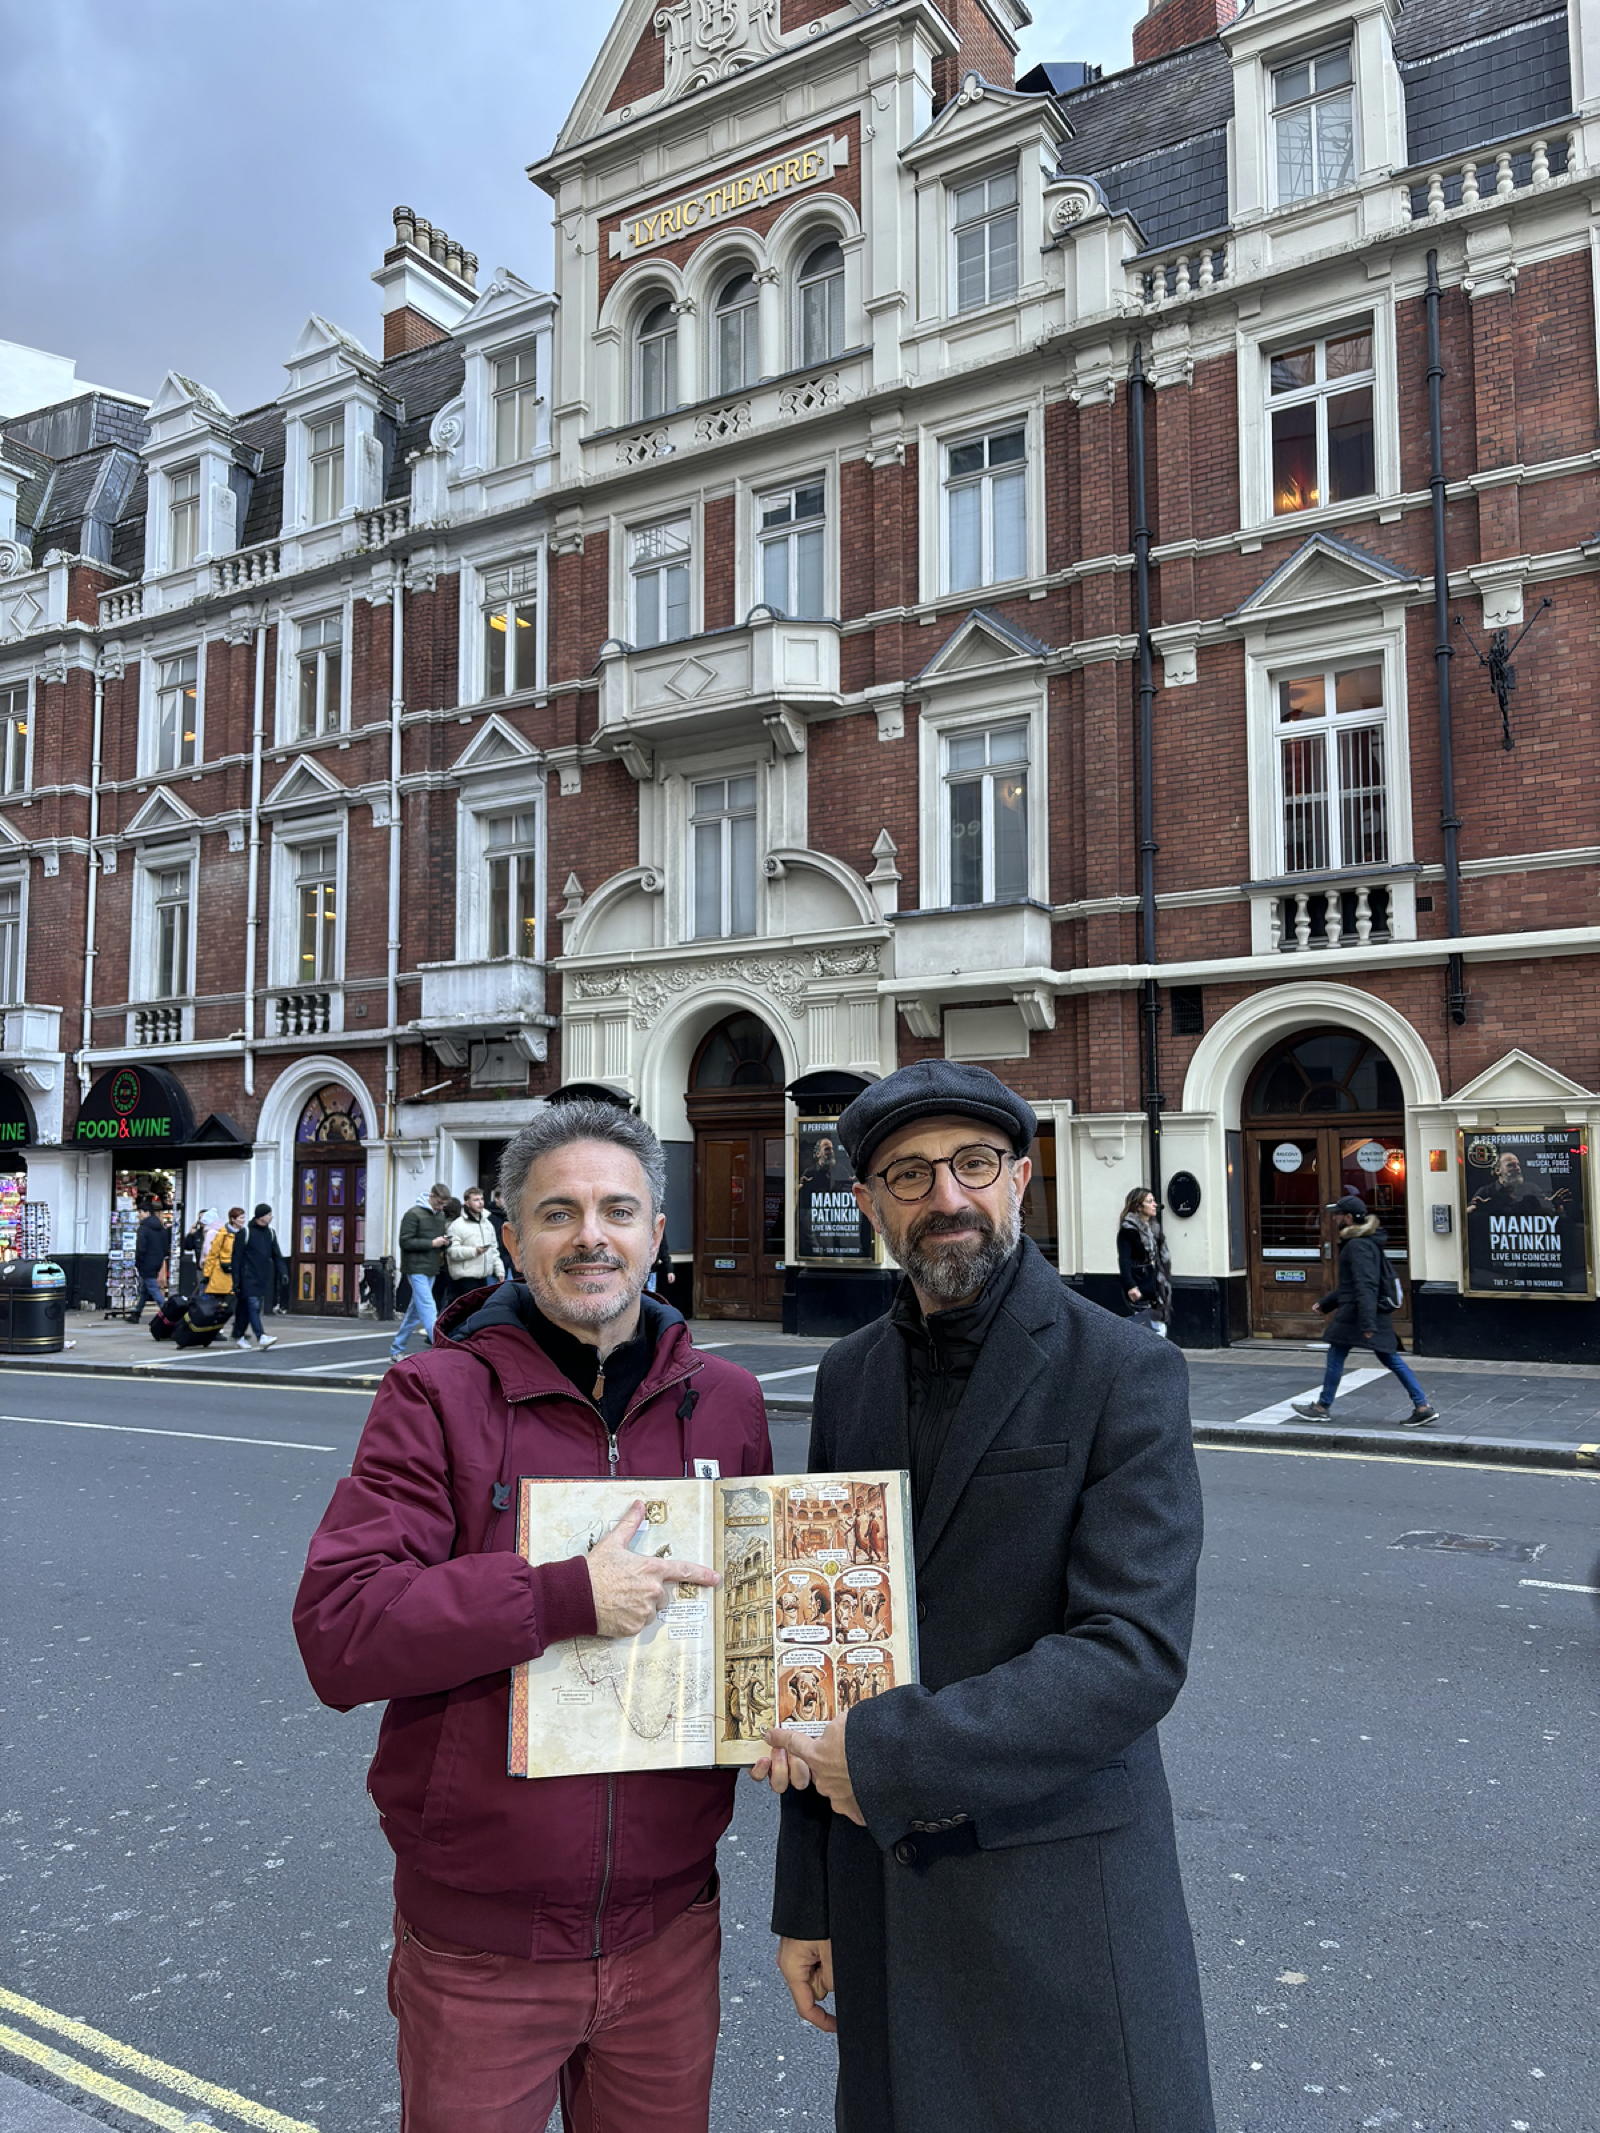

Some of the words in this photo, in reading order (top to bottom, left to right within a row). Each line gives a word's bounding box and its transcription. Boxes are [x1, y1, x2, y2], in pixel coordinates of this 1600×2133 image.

[635, 200, 699, 249] LYRIC
[705, 151, 818, 218] THEATRE
[1481, 1134, 1546, 1145] PERFORMANCES
[1548, 1134, 1569, 1143] ONLY
[811, 1192, 857, 1207] MANDY
[811, 1208, 860, 1222] PATINKIN
[1489, 1216, 1560, 1233] MANDY
[1490, 1234, 1561, 1251] PATINKIN
[1491, 1253, 1510, 1261] LIVE
[1511, 1253, 1520, 1261] IN
[1522, 1253, 1561, 1261] CONCERT
